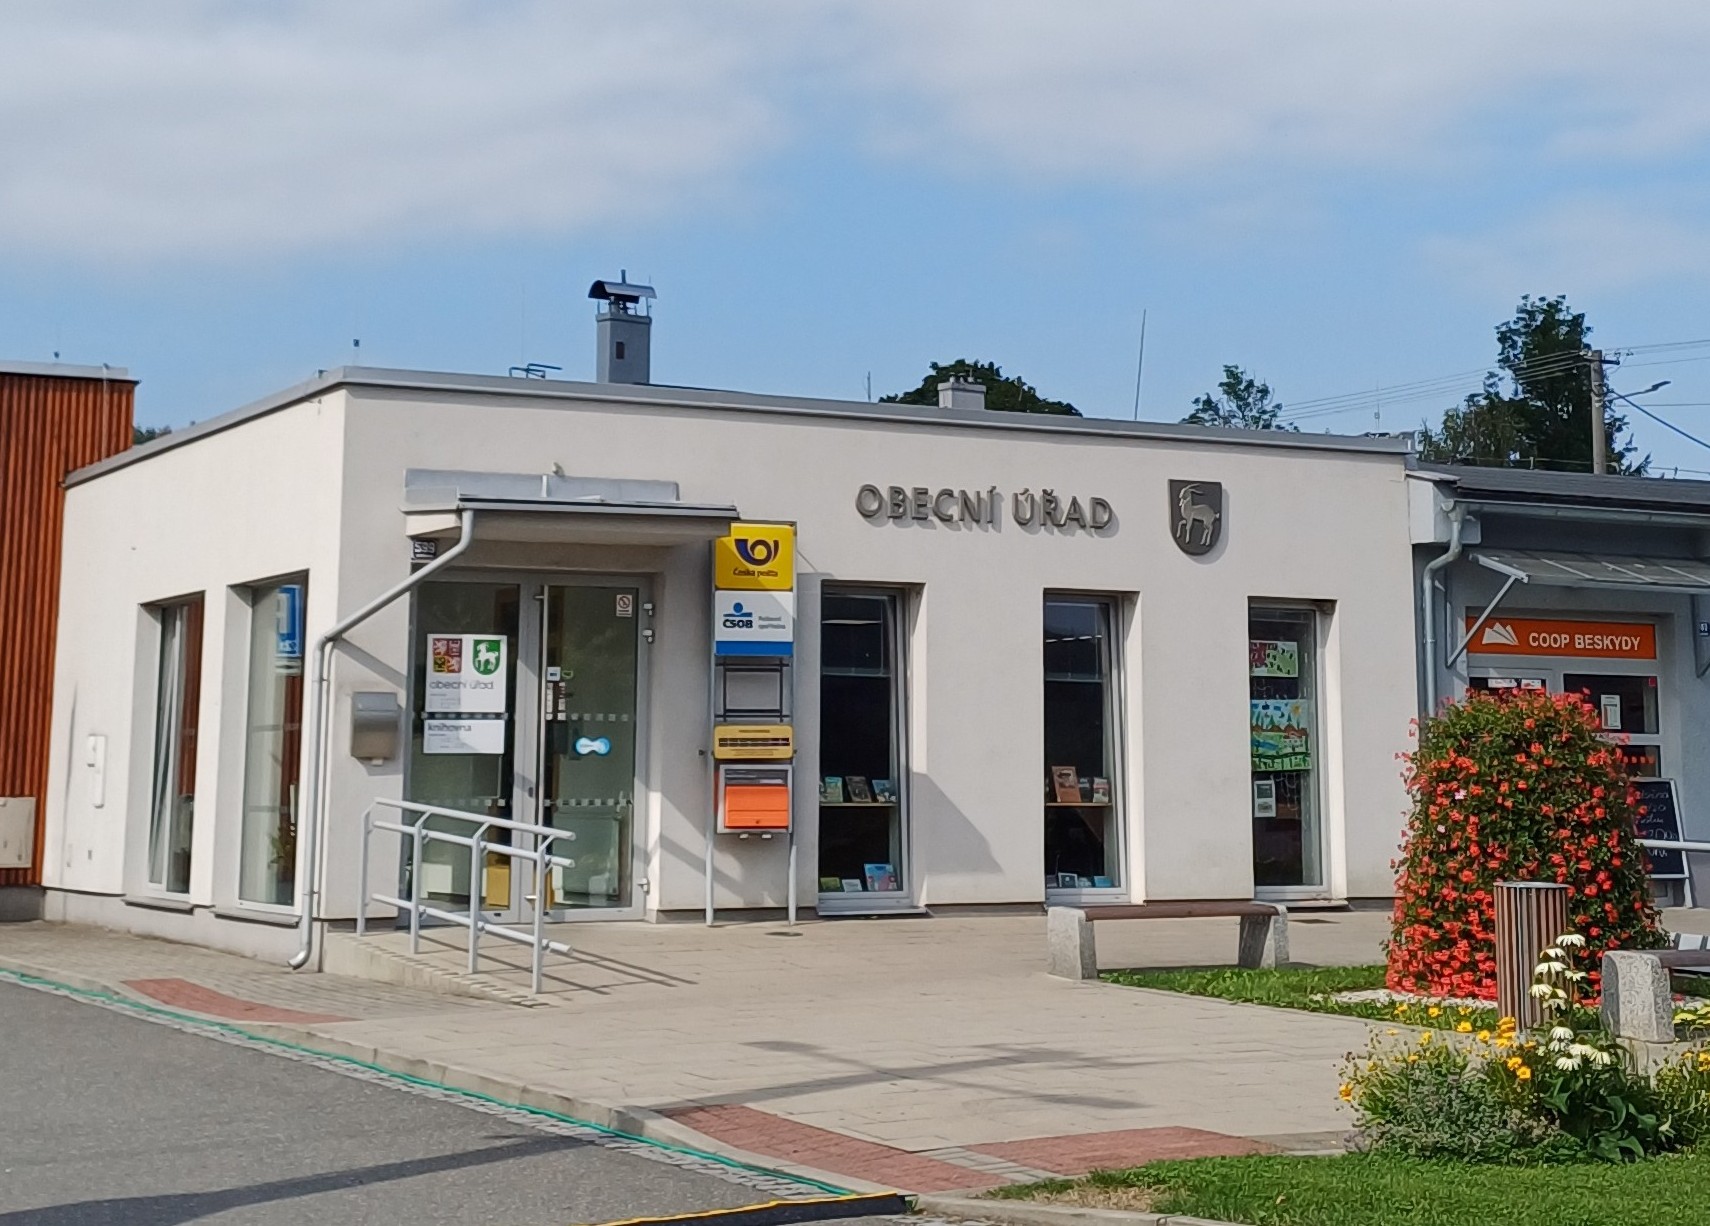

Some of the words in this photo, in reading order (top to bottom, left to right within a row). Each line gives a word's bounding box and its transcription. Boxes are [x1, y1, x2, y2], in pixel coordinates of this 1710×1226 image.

[855, 483, 997, 524] OBECNÍ
[1012, 487, 1114, 530] ÚŘAD
[1529, 632, 1570, 648] COOP
[1574, 634, 1641, 651] BESKYDY
